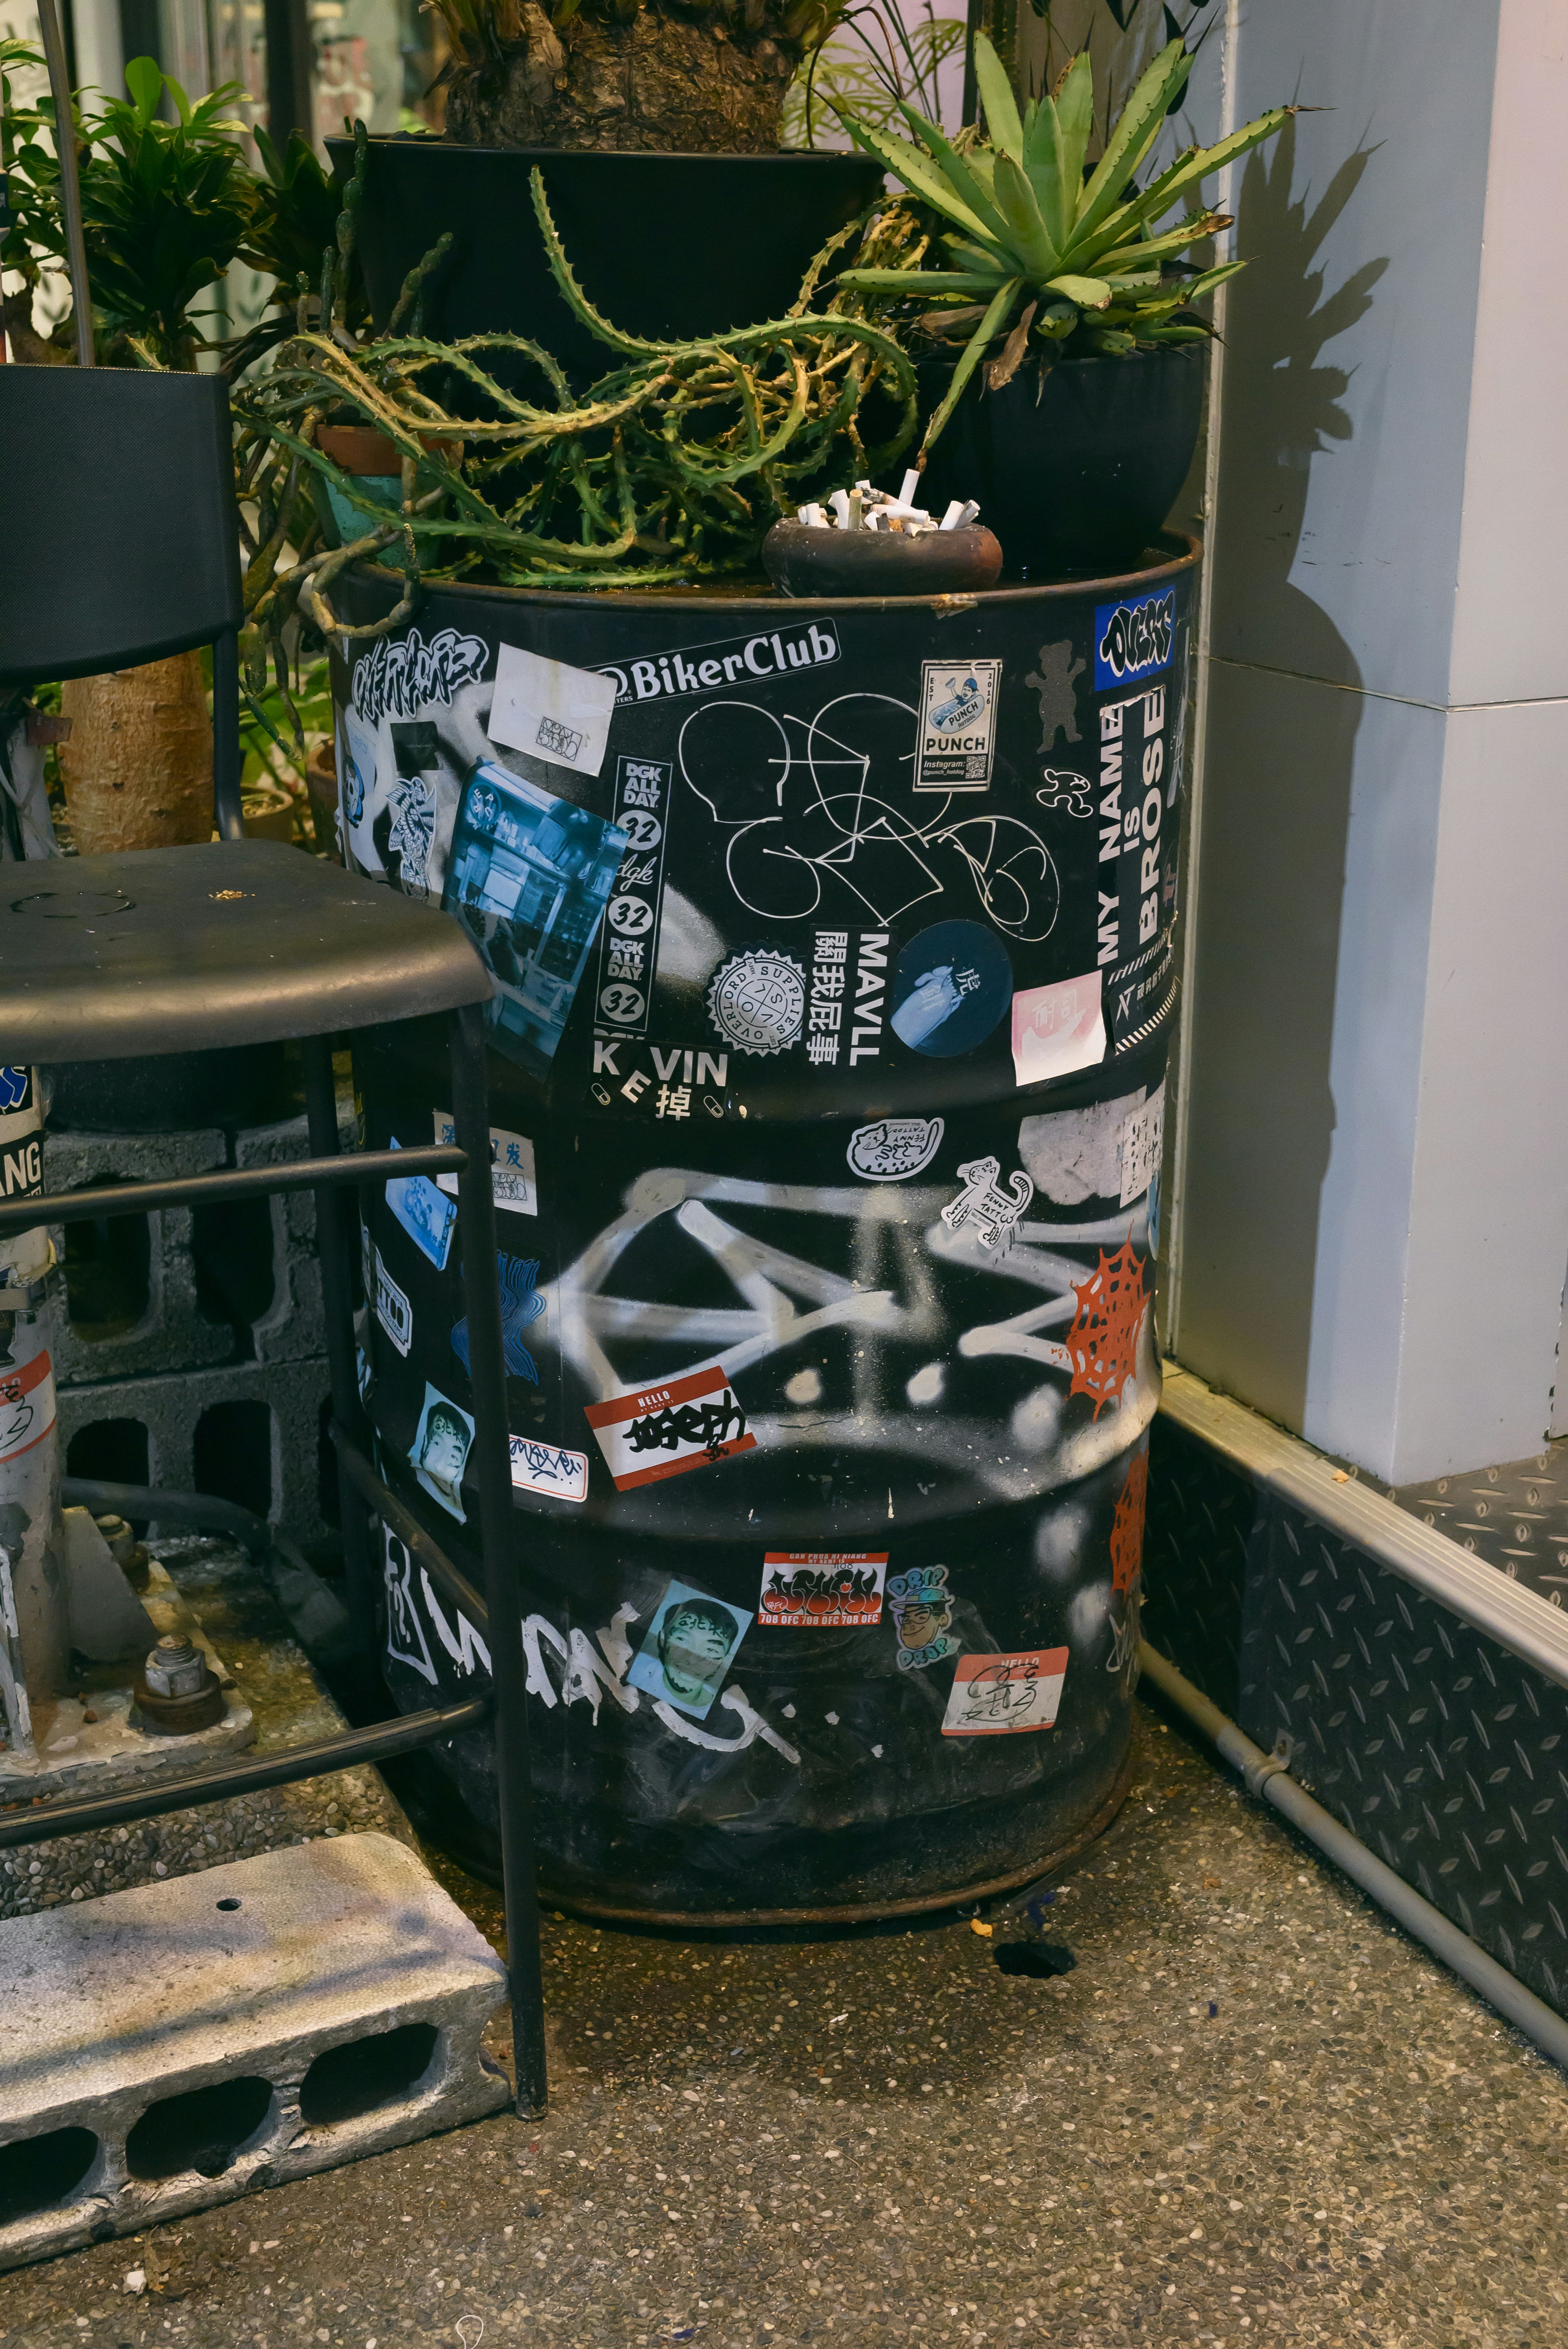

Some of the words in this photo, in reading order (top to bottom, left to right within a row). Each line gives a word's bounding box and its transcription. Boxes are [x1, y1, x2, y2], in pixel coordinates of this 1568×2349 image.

[631, 625, 836, 699] BikerClub
[948, 702, 978, 726] PUNCH
[958, 714, 976, 728] HOTDOG
[926, 737, 985, 751] PUNCH
[626, 763, 662, 781] DGK
[924, 760, 966, 770] Instagram:
[625, 777, 661, 795] ALL
[1099, 704, 1123, 863] NAME
[1124, 807, 1140, 852] IS
[1139, 689, 1165, 945] BROSE
[625, 817, 657, 843] 32
[613, 903, 648, 928] 32
[1098, 891, 1119, 966] MY
[610, 937, 645, 955] DGK
[608, 951, 643, 968] ALL
[605, 990, 640, 1015] 32
[724, 973, 763, 1039] OVERLORD
[761, 966, 801, 1035] SUPPLIES
[806, 932, 848, 1065] 關我屁事
[850, 934, 889, 1066] MAVLL
[656, 1084, 691, 1121] 掉
[893, 1134, 925, 1142] FENNY
[983, 1193, 1009, 1210] FENNY
[638, 1390, 670, 1407] HELLO
[889, 1567, 945, 1596] DRIP
[761, 1614, 778, 1624] 708
[781, 1616, 799, 1625] OFC
[802, 1616, 819, 1625] 708
[821, 1616, 839, 1625] OFC
[841, 1615, 859, 1624] 708
[861, 1614, 878, 1624] OFC
[899, 1638, 948, 1667] DROP
[1000, 1657, 1040, 1669] HELLO
